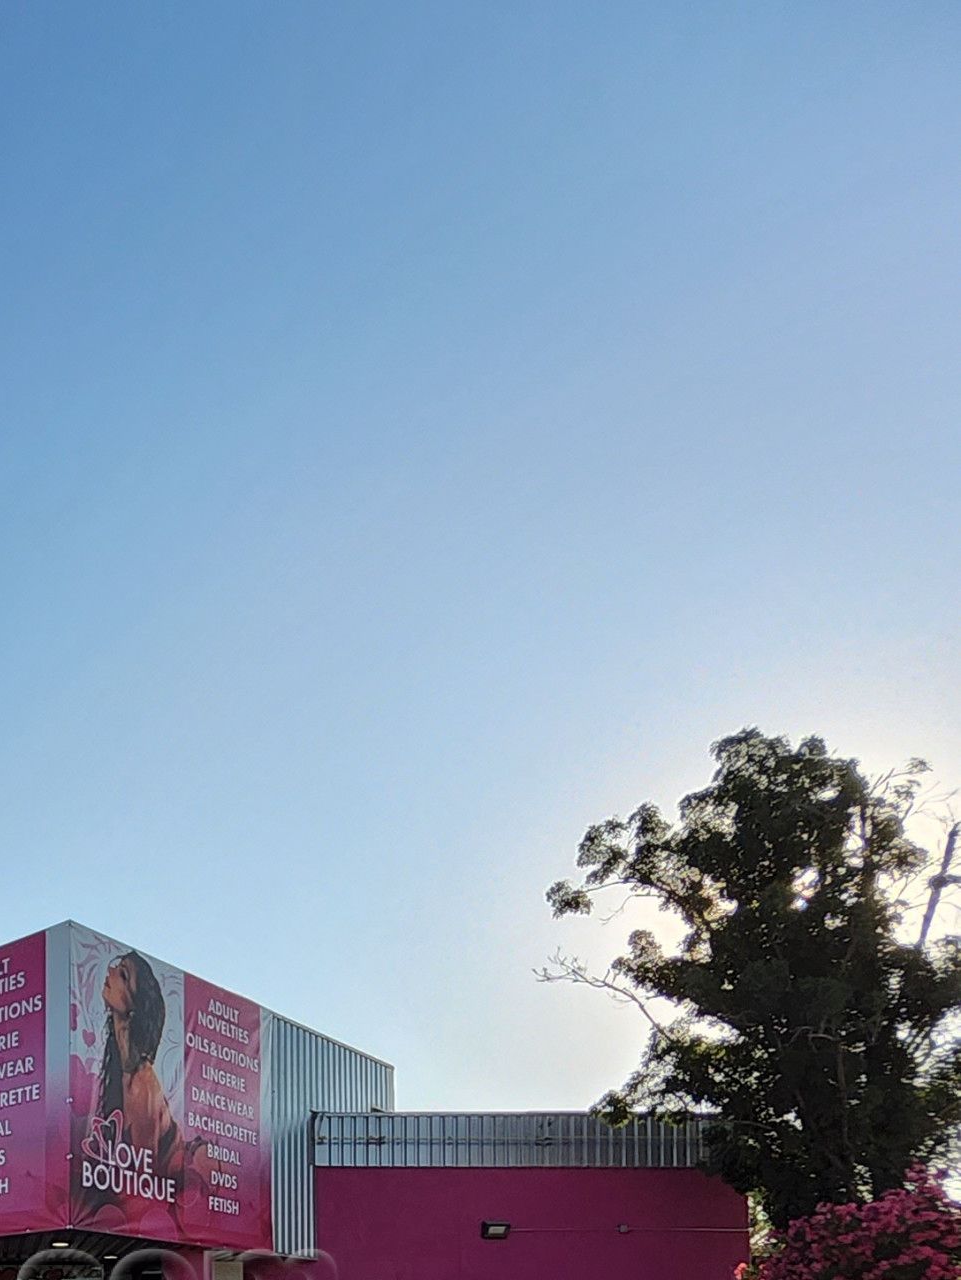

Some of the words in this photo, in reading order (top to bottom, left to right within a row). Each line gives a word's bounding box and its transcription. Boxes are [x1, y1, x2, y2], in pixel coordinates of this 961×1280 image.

[208, 998, 239, 1024] ADULT
[198, 1010, 249, 1044] NOVELTIES
[202, 1064, 246, 1092] LINGERIE
[188, 1112, 257, 1145] BACHELORETTE
[108, 1140, 153, 1174] LOVE
[207, 1144, 241, 1165] BRIDAL
[82, 1160, 176, 1203] BOUTIQUE
[211, 1170, 238, 1190] DVDS
[208, 1196, 239, 1215] FETISH
